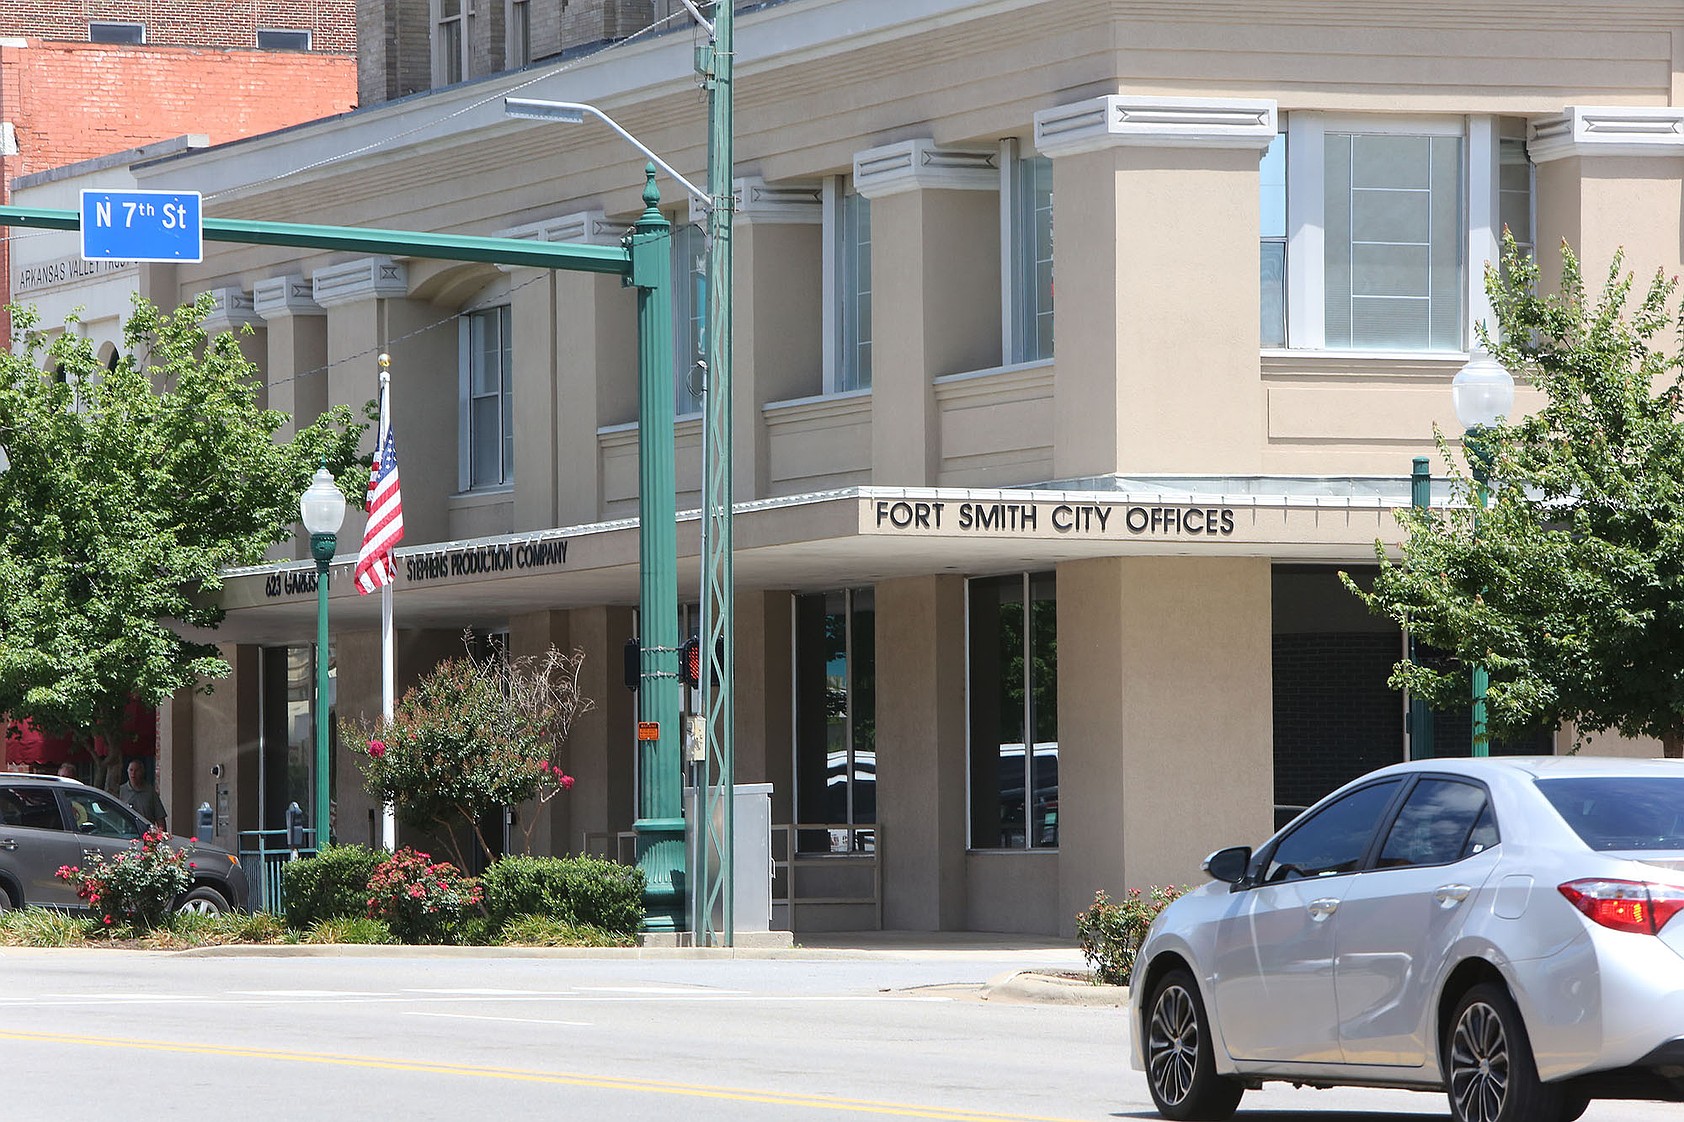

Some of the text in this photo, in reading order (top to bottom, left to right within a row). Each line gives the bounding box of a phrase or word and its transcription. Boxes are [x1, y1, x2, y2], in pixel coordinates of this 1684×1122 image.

[96, 202, 187, 229] N 7th St
[20, 262, 66, 289] ARKANSAS
[68, 260, 99, 279] VALLEY
[876, 501, 1235, 535] FORT SMITH CITY OFFICES
[406, 541, 568, 581] STEPHENS PRODUCTION COMPANY
[265, 571, 331, 597] 623 GARRIS
